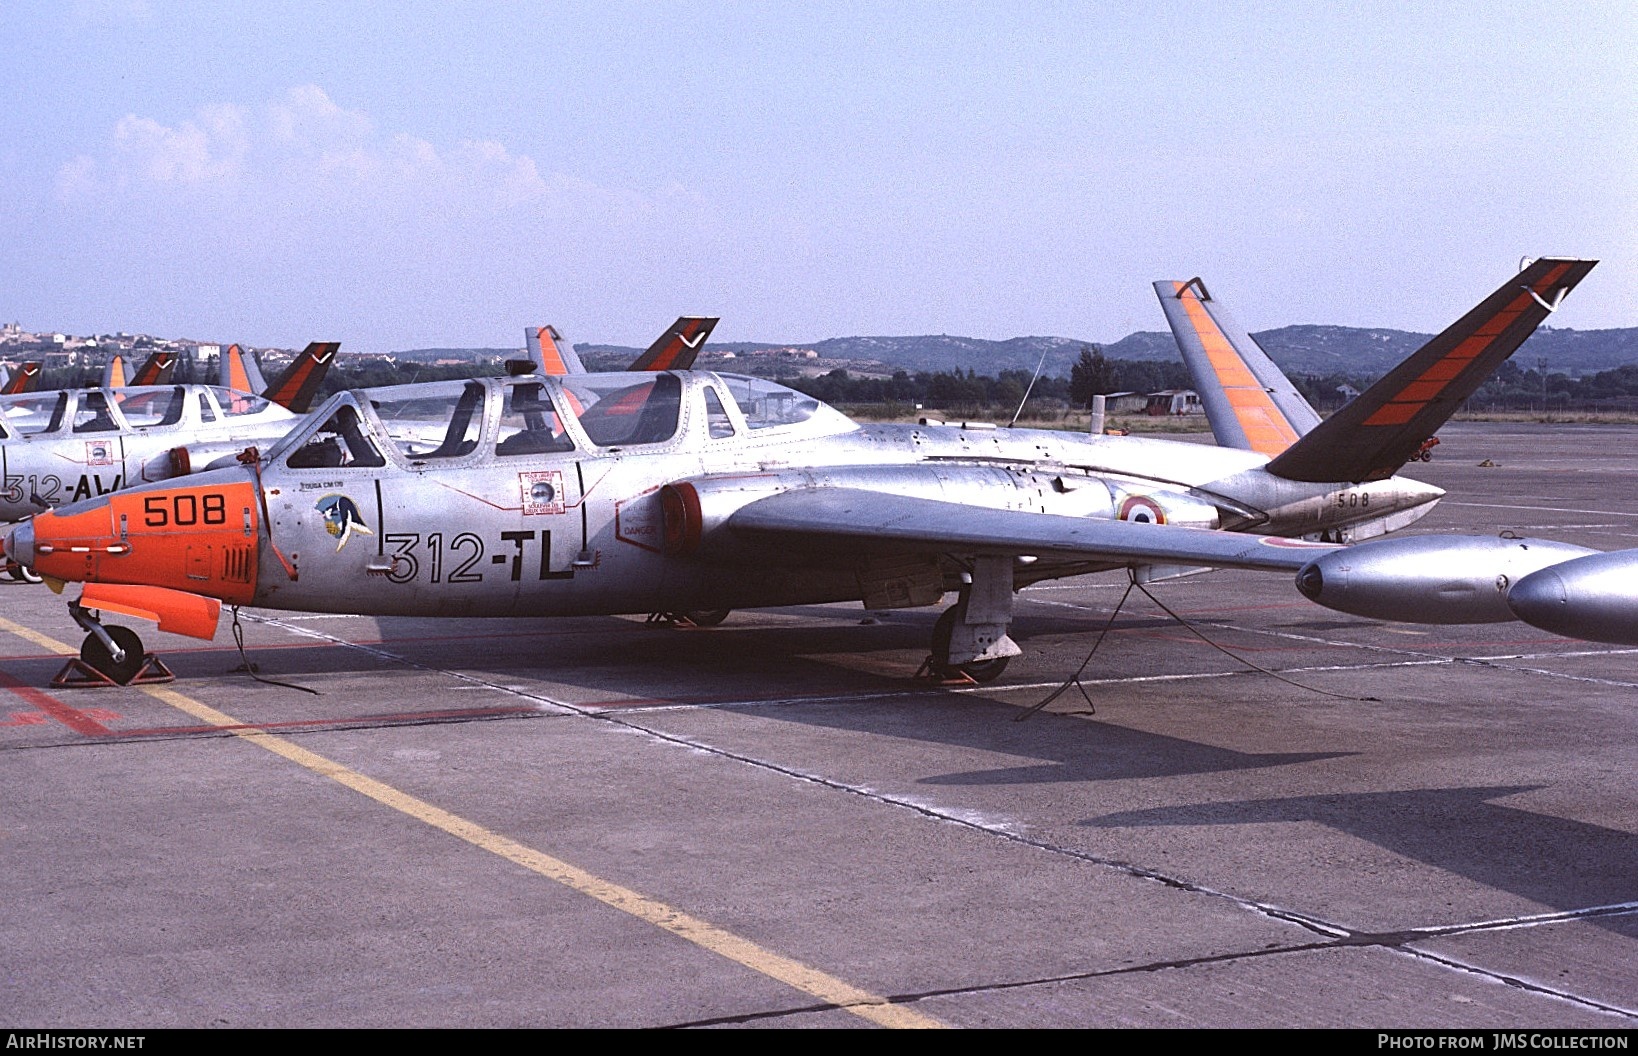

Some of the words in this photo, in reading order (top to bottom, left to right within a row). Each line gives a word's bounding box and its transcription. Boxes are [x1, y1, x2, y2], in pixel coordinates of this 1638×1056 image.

[4, 474, 122, 503] 312-AW
[1337, 492, 1369, 508] 508
[144, 494, 226, 527] 508
[624, 525, 657, 535] DANGER
[385, 529, 575, 584] 312-TL
